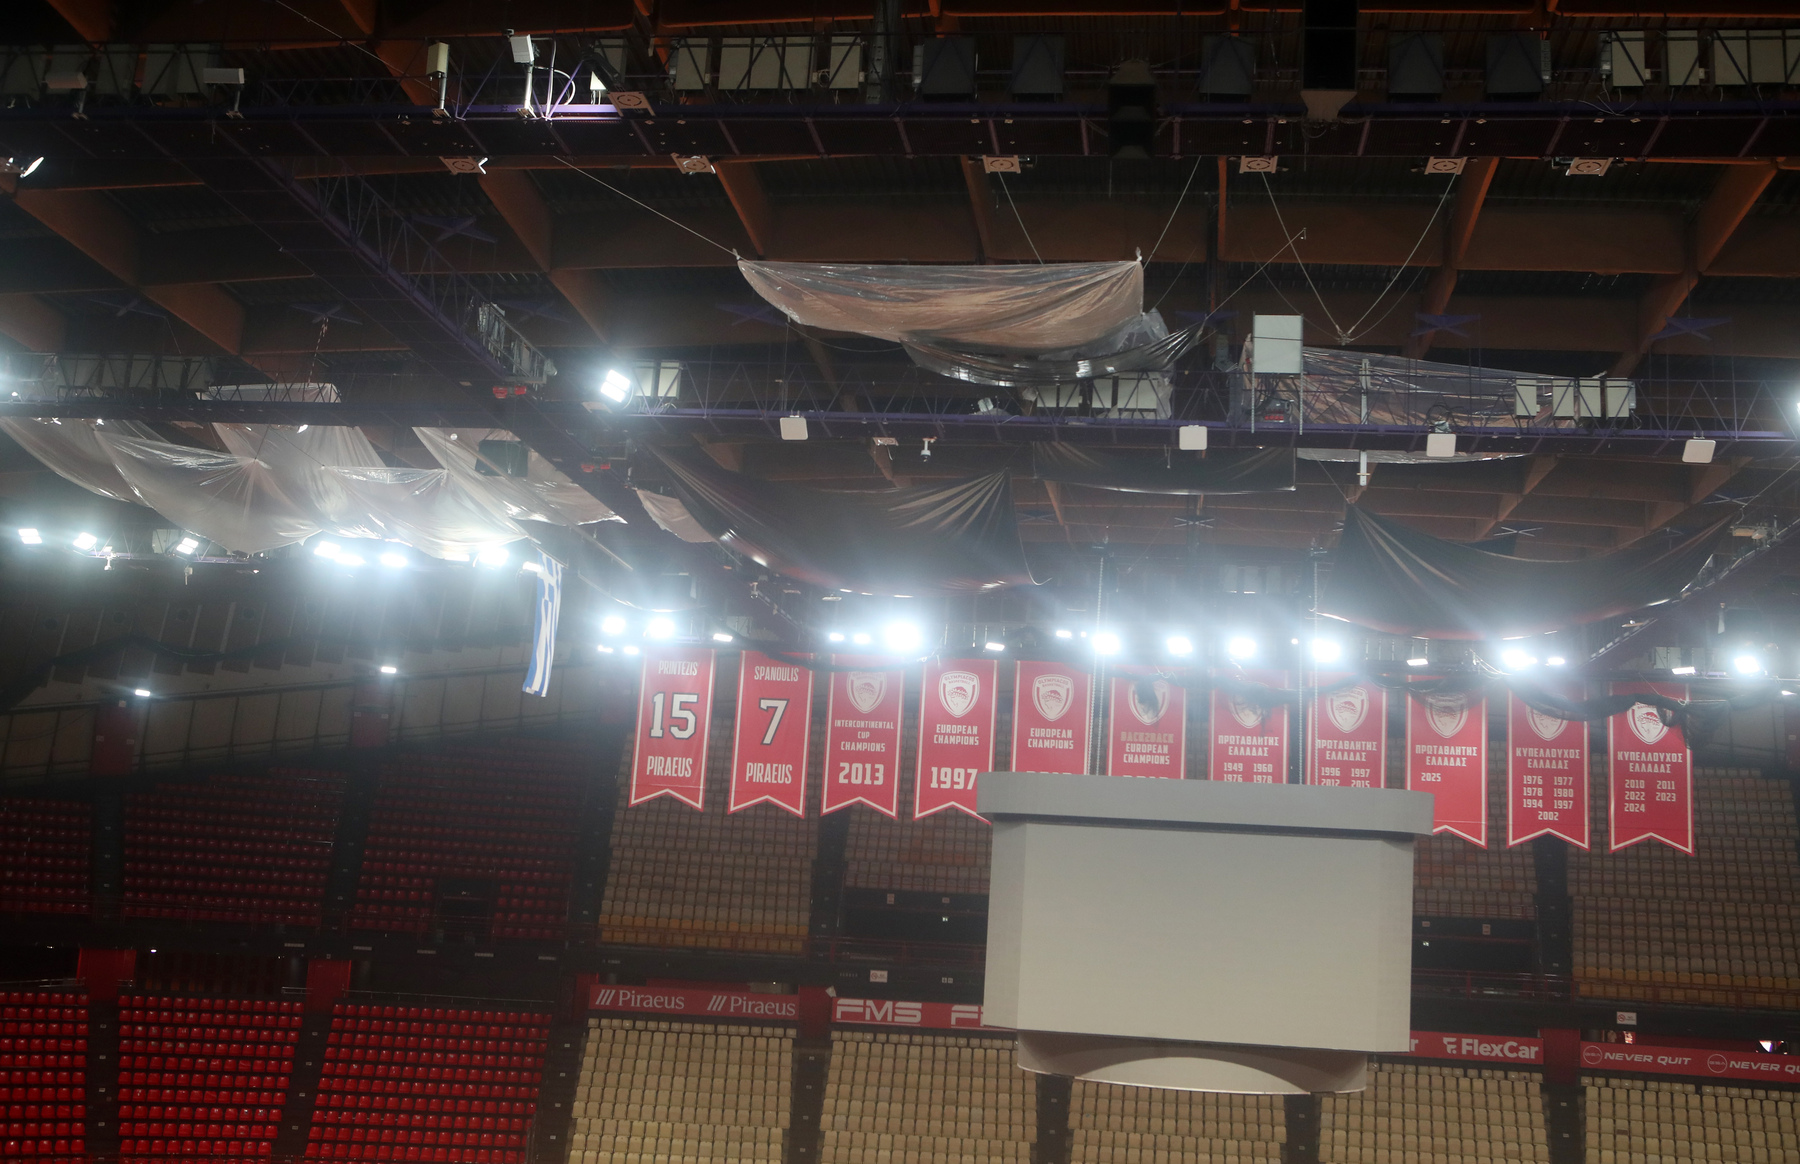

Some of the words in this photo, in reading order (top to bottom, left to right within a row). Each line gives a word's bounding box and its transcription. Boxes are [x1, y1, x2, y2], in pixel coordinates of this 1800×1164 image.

[658, 659, 698, 677] PRINTEZIS
[754, 665, 799, 682] SPANOULIS
[649, 692, 699, 740] 15
[758, 698, 790, 745] 7
[834, 720, 895, 730] INTERCONTINENTAL
[935, 724, 978, 735] EUROPEAN
[857, 731, 870, 739] CUP
[1030, 728, 1073, 739] EUROPEAN
[933, 735, 980, 746] CHAMPIONS
[1027, 739, 1074, 750] CHAMPIONS
[840, 742, 886, 752] CHAMPIONS
[1125, 743, 1169, 754] EUROPEAN
[1228, 747, 1269, 757] ΕΛΛΑΔΑΣ
[1326, 750, 1367, 762] ΕΛΛΑΔΑΣ
[1515, 747, 1581, 759] ΚΥΠΕΛΛΟΥΧΟΣ
[1617, 751, 1683, 763] ΚΥΠΕΛΛΟΥΧΟΣ
[1123, 754, 1170, 765] CHAMPIONS
[1426, 756, 1467, 767] ΕΛΛΑΔΑΣ
[1527, 759, 1569, 769] ΕΛΛΑΔΑΣ
[646, 756, 693, 778] PIRAEUS
[1223, 762, 1244, 772] 1949
[1253, 763, 1273, 773] 1960
[1321, 767, 1341, 777] 1996
[1351, 768, 1371, 778] 1997
[1629, 762, 1672, 774] ΕΛΛΑΔΑΣ
[745, 762, 793, 785] PIRAEUS
[838, 762, 885, 785] 2013
[930, 766, 978, 790] 1997
[1223, 774, 1243, 783] 1976
[1253, 775, 1273, 784] 1978
[1421, 772, 1442, 782] 2025
[1321, 778, 1340, 787] 2012
[1351, 780, 1371, 788] 2015
[1523, 775, 1543, 785] 1976
[1553, 776, 1574, 786] 1977
[1624, 778, 1646, 789] 2010
[1656, 780, 1676, 790] 2011
[1523, 787, 1543, 797] 1978
[1553, 788, 1574, 798] 1980
[1624, 790, 1646, 801] 2022
[1655, 792, 1677, 802] 2023
[1523, 798, 1543, 809] 1994
[1553, 799, 1574, 810] 1997
[1624, 802, 1646, 813] 2024
[1537, 811, 1559, 821] 2002
[618, 988, 686, 1012] Piraeus
[728, 994, 797, 1018] Piraeus
[836, 998, 922, 1023] FMS
[1461, 1038, 1539, 1059] FlexCar
[1604, 1051, 1653, 1063] NEVER
[1657, 1055, 1692, 1066] QUIT
[1729, 1061, 1780, 1072] NEVER
